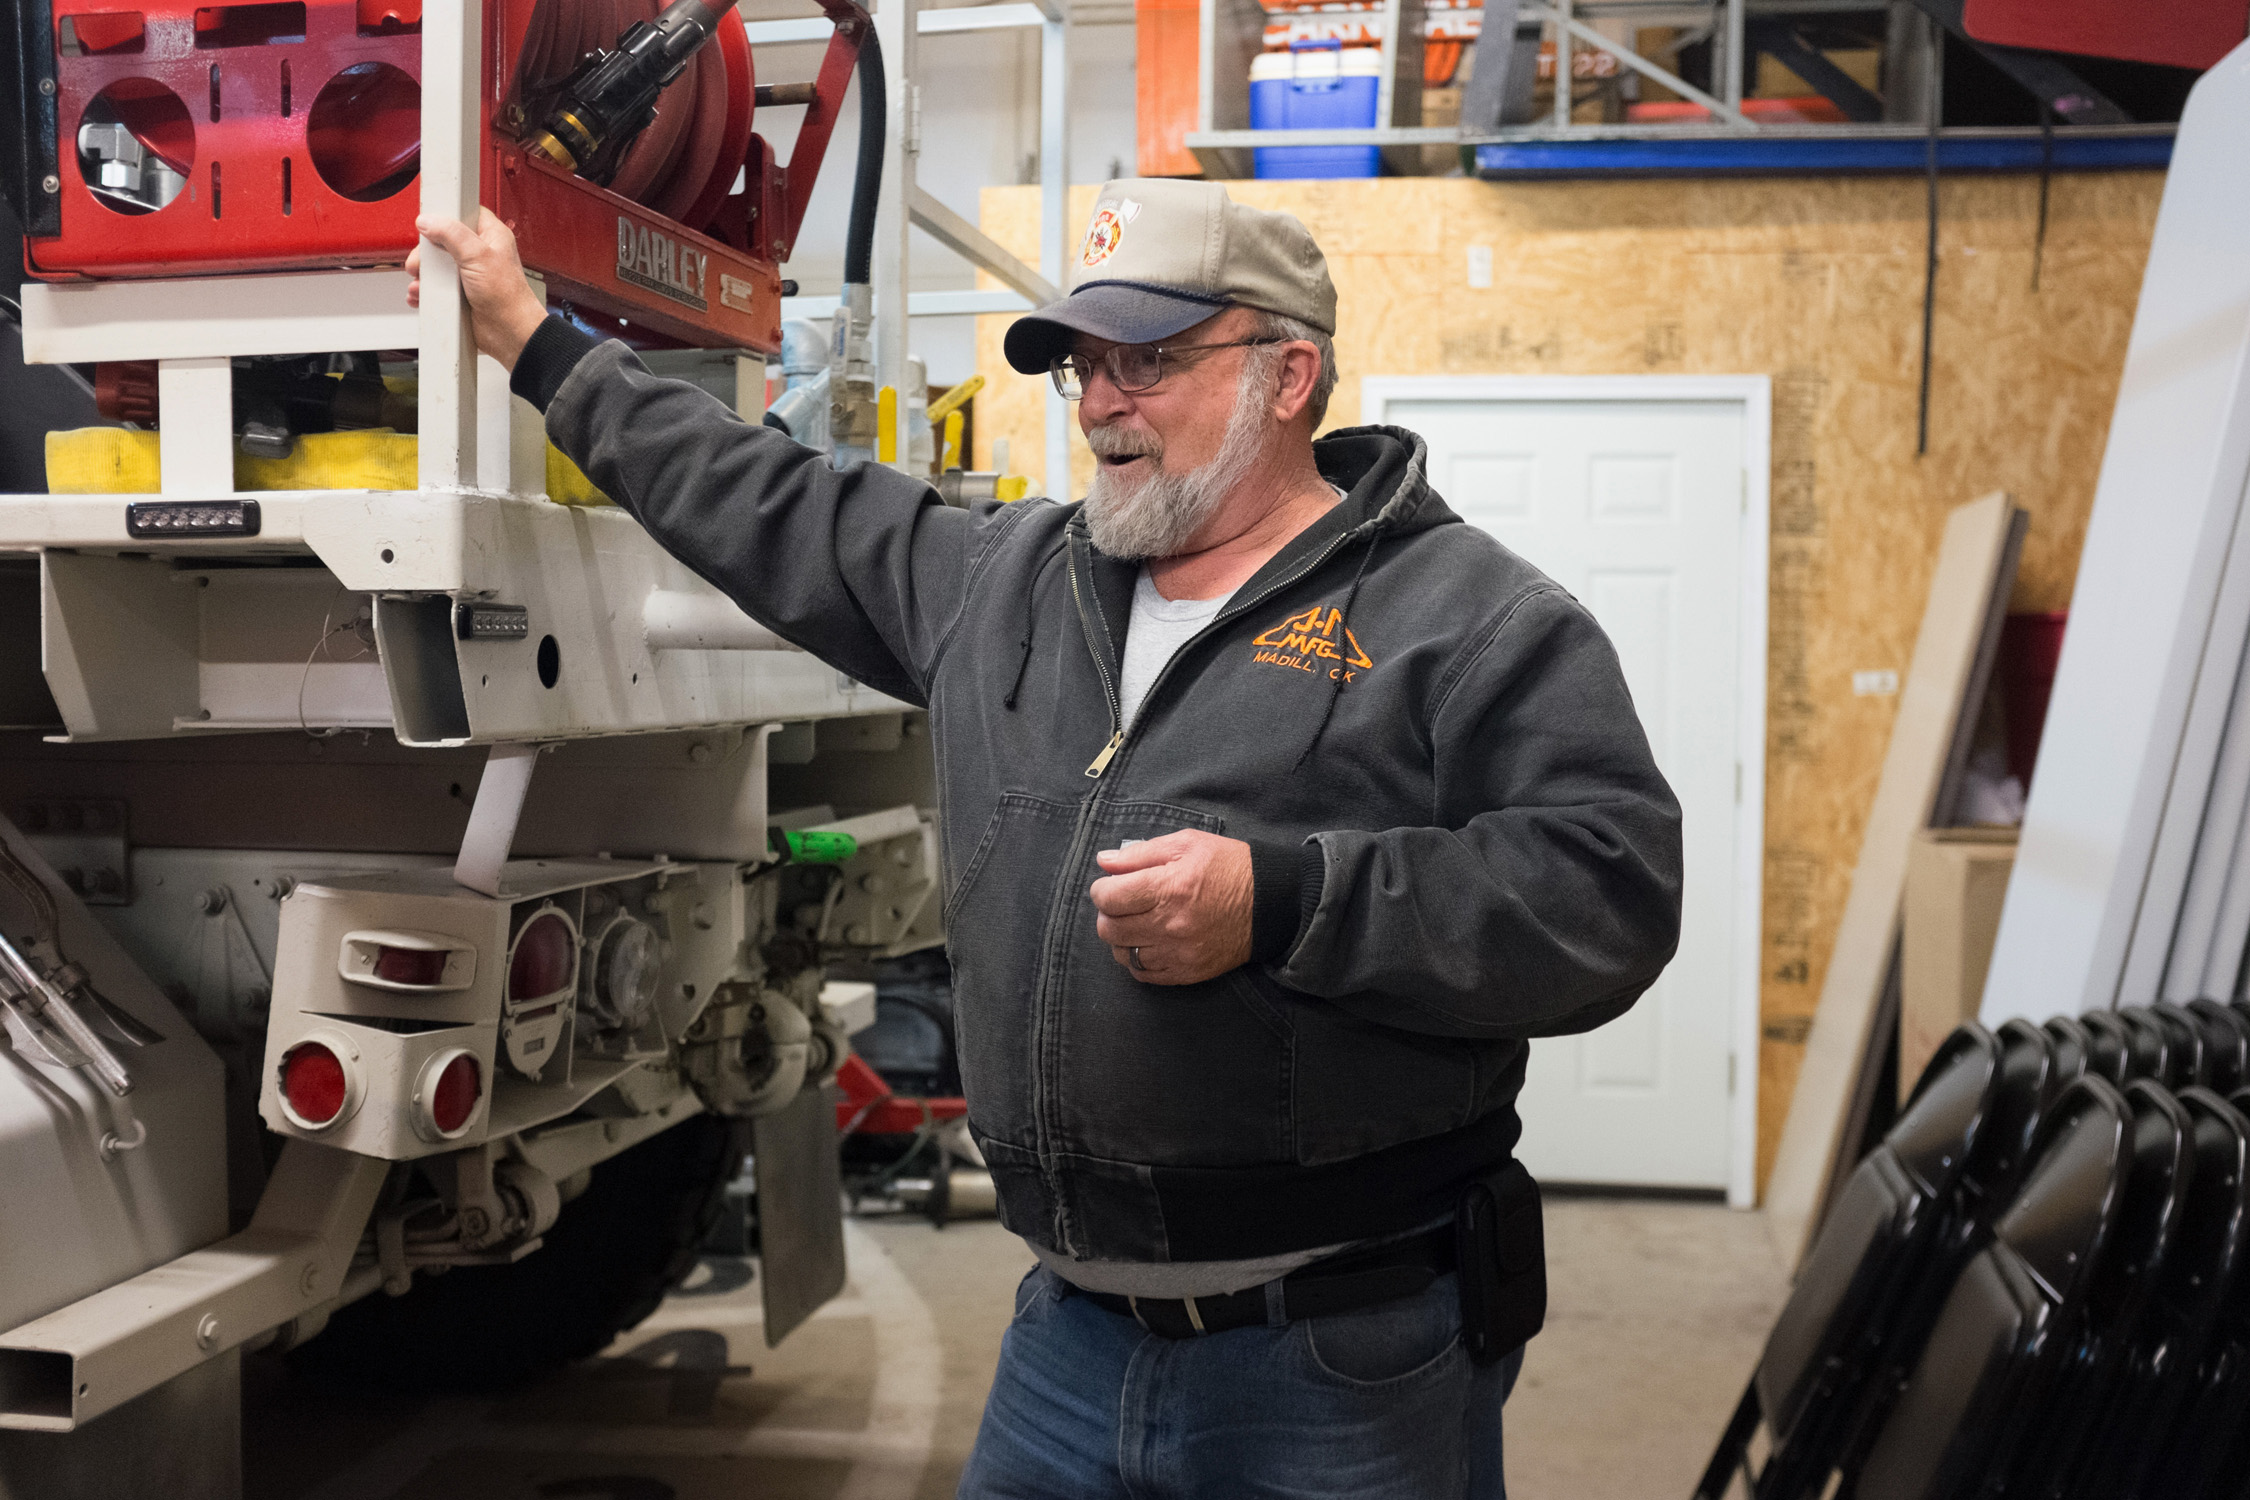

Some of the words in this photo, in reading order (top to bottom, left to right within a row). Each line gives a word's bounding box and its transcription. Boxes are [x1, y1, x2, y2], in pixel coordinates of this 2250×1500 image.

[618, 216, 707, 299] DARLEY
[1277, 632, 1337, 659] MFG
[1252, 650, 1317, 674] MADILL,
